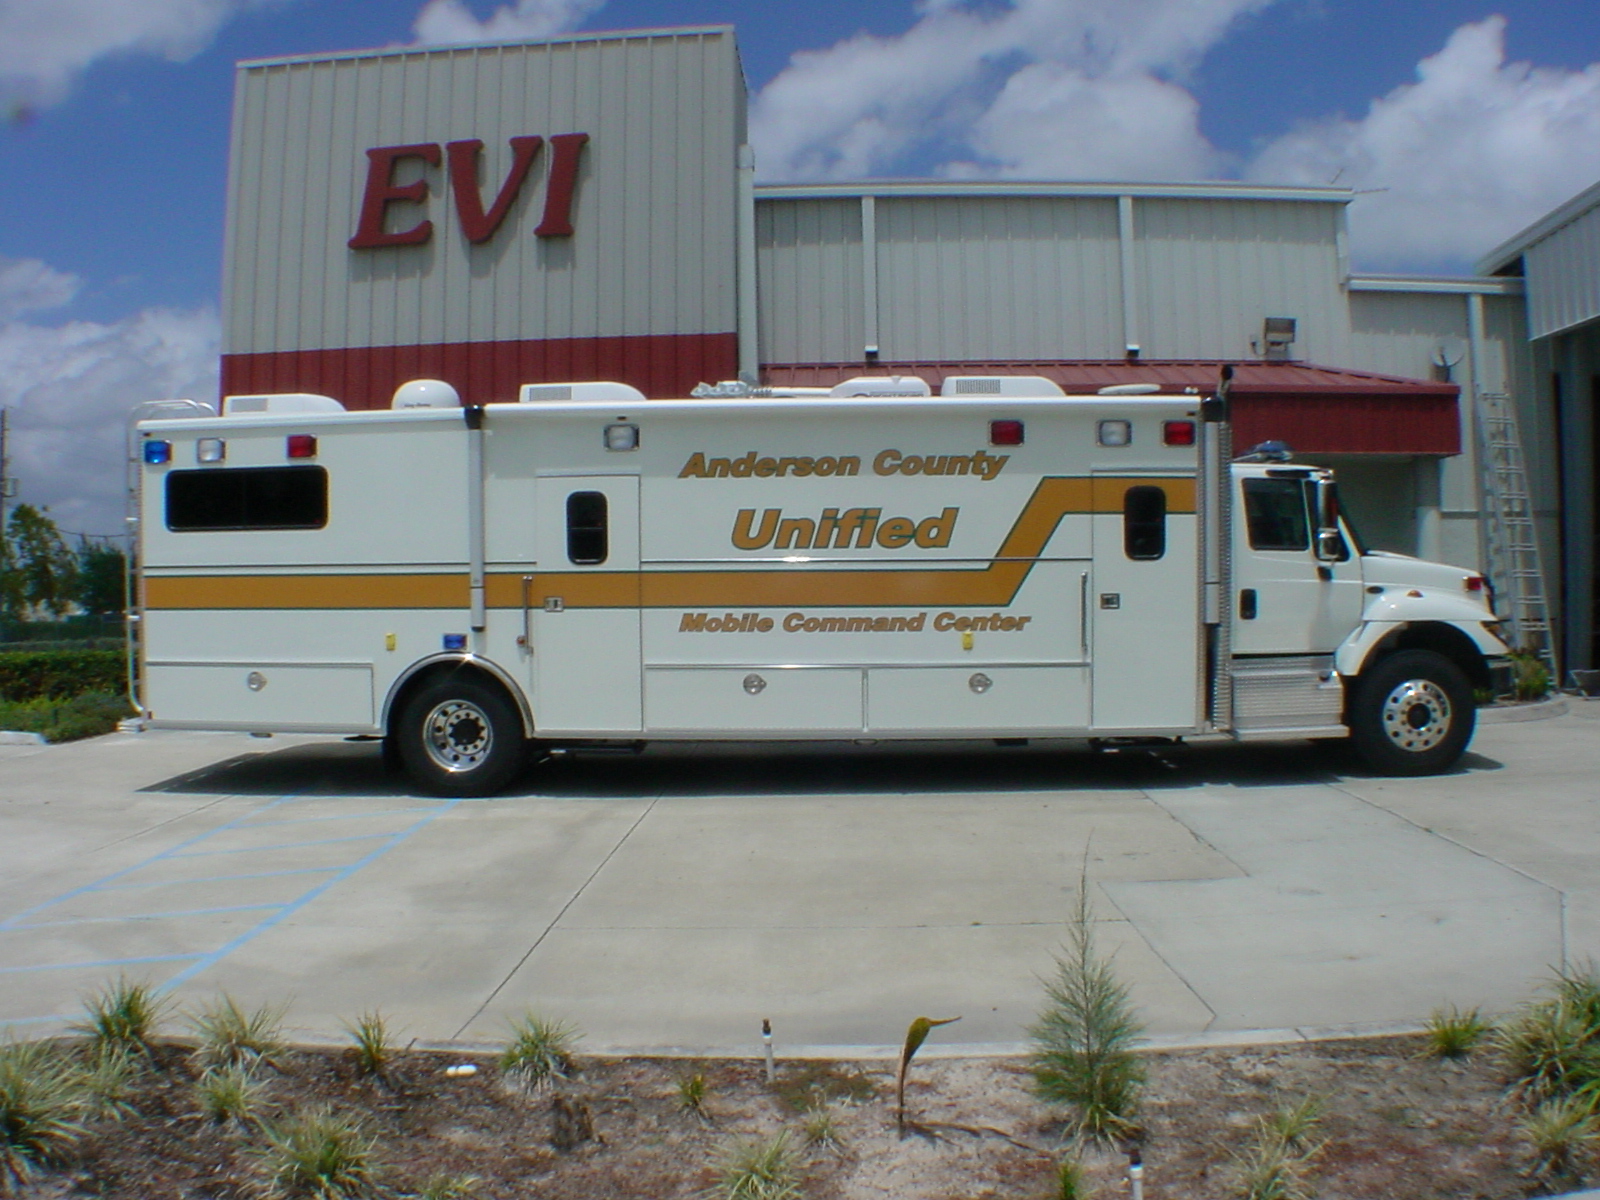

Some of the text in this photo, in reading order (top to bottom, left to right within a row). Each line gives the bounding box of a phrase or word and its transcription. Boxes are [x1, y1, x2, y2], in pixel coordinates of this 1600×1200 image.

[347, 132, 590, 249] EVI
[678, 449, 1011, 481] Anderson County
[731, 507, 960, 550] Unified
[679, 612, 1032, 633] Mobile Command Center
